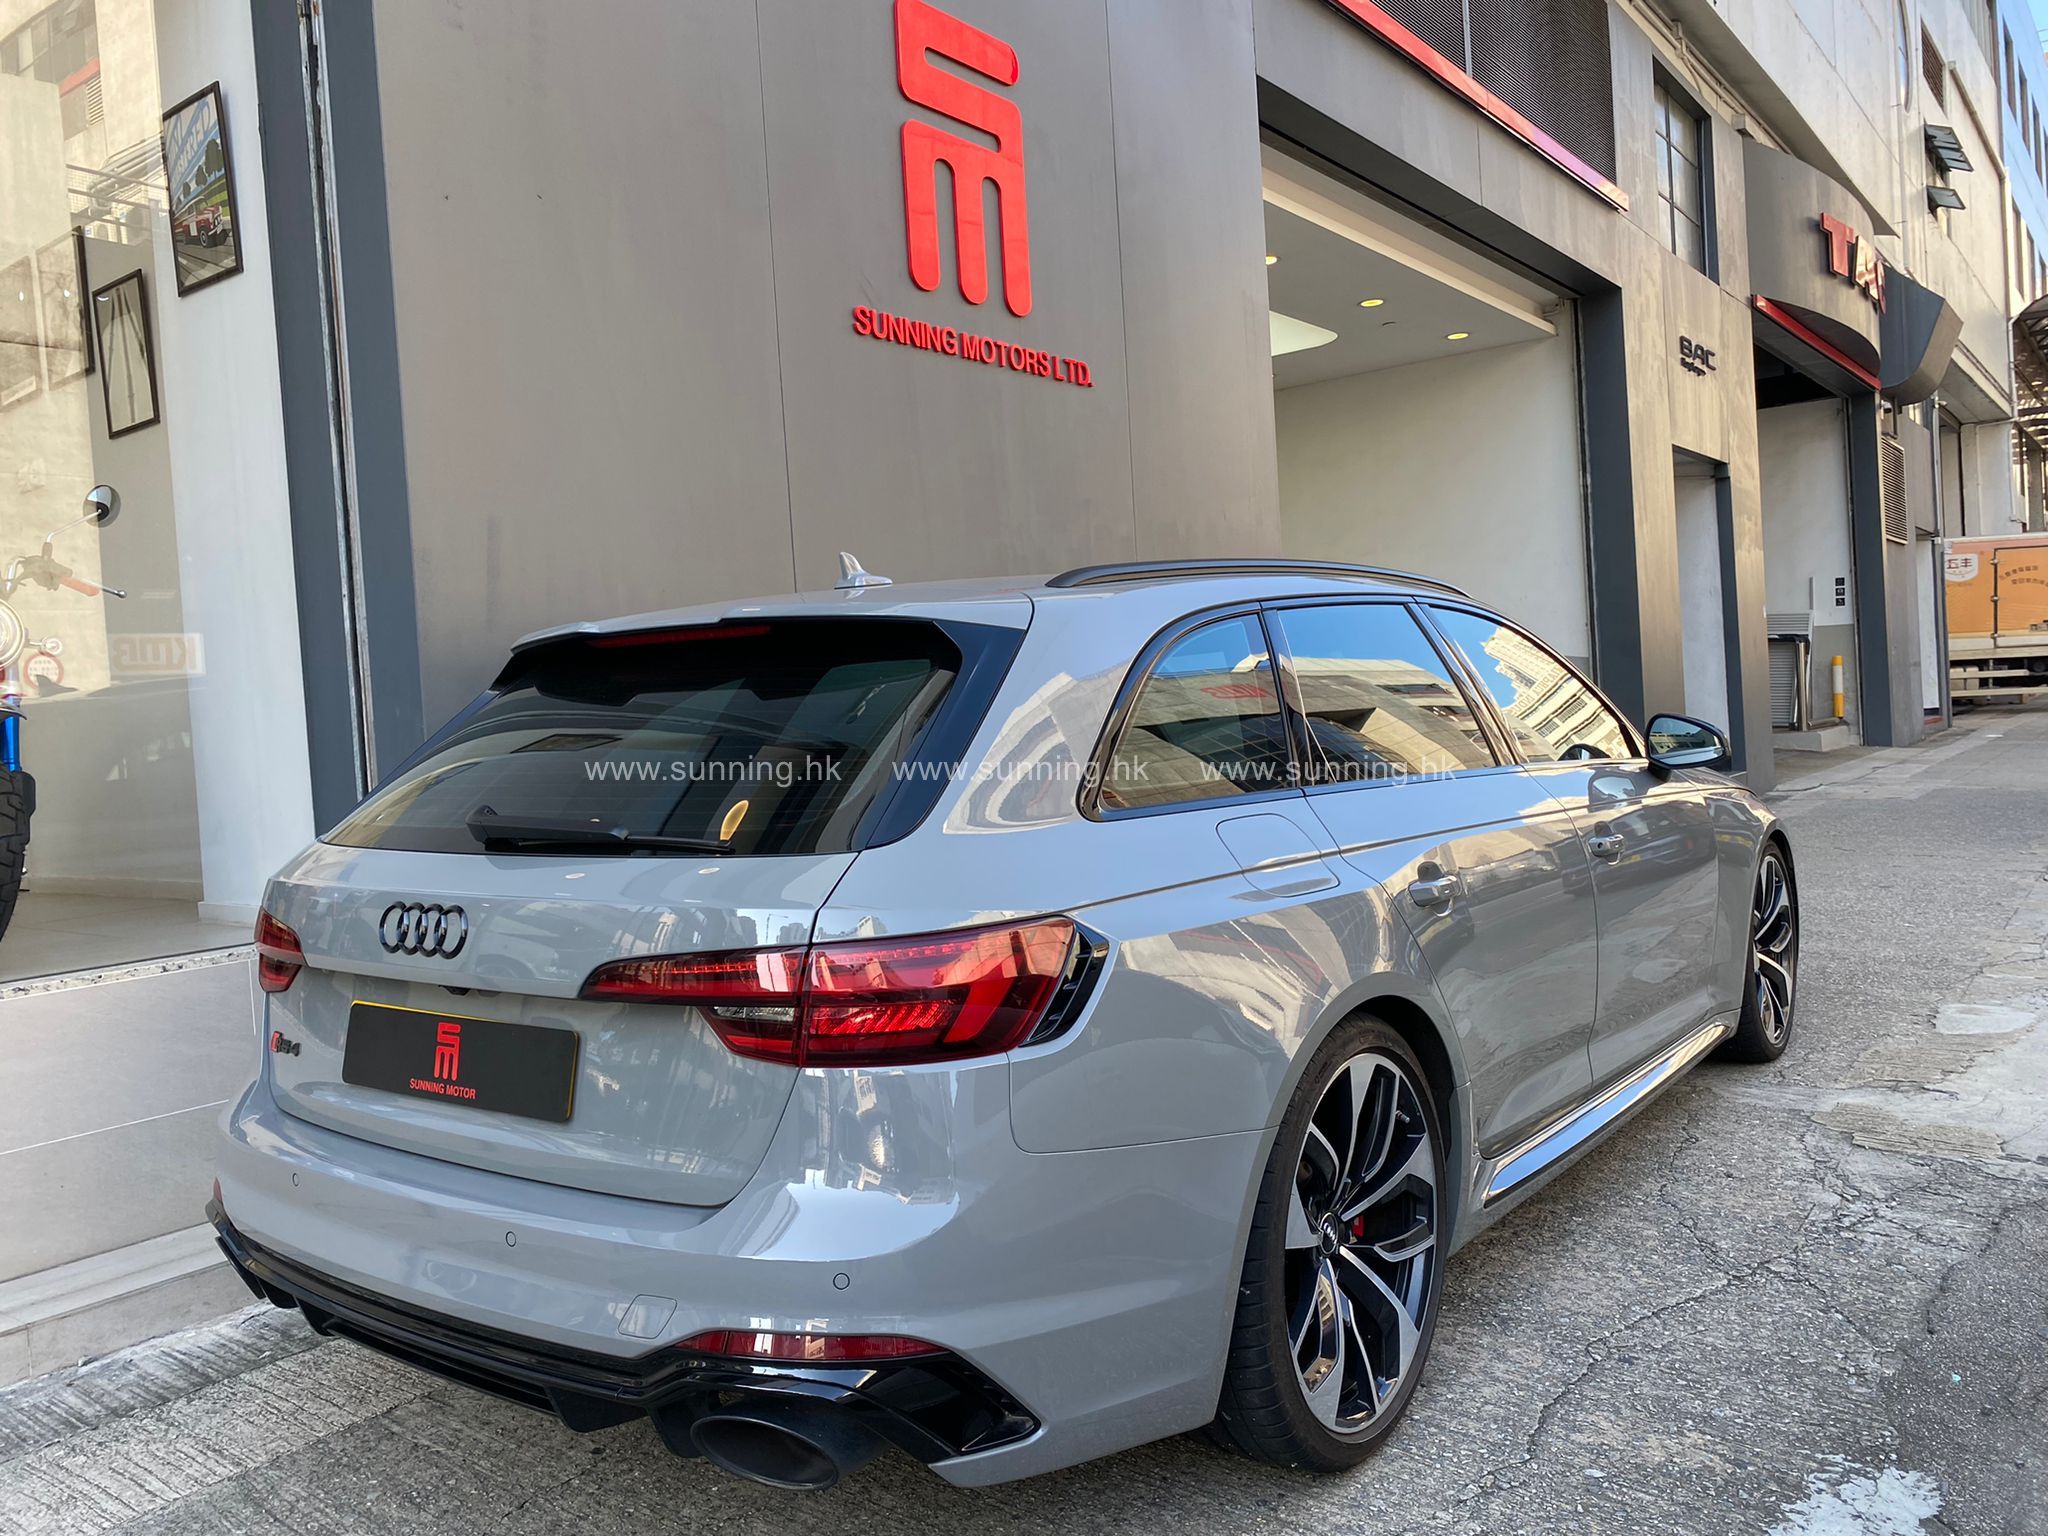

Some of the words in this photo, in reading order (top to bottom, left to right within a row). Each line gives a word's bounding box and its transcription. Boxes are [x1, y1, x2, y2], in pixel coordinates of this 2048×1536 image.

[853, 305, 958, 356] SUNNING
[960, 332, 1050, 377] MOTORS
[1679, 335, 1717, 371] BAC
[409, 1078, 445, 1094] SUNNING
[446, 1084, 476, 1100] MOTOR
